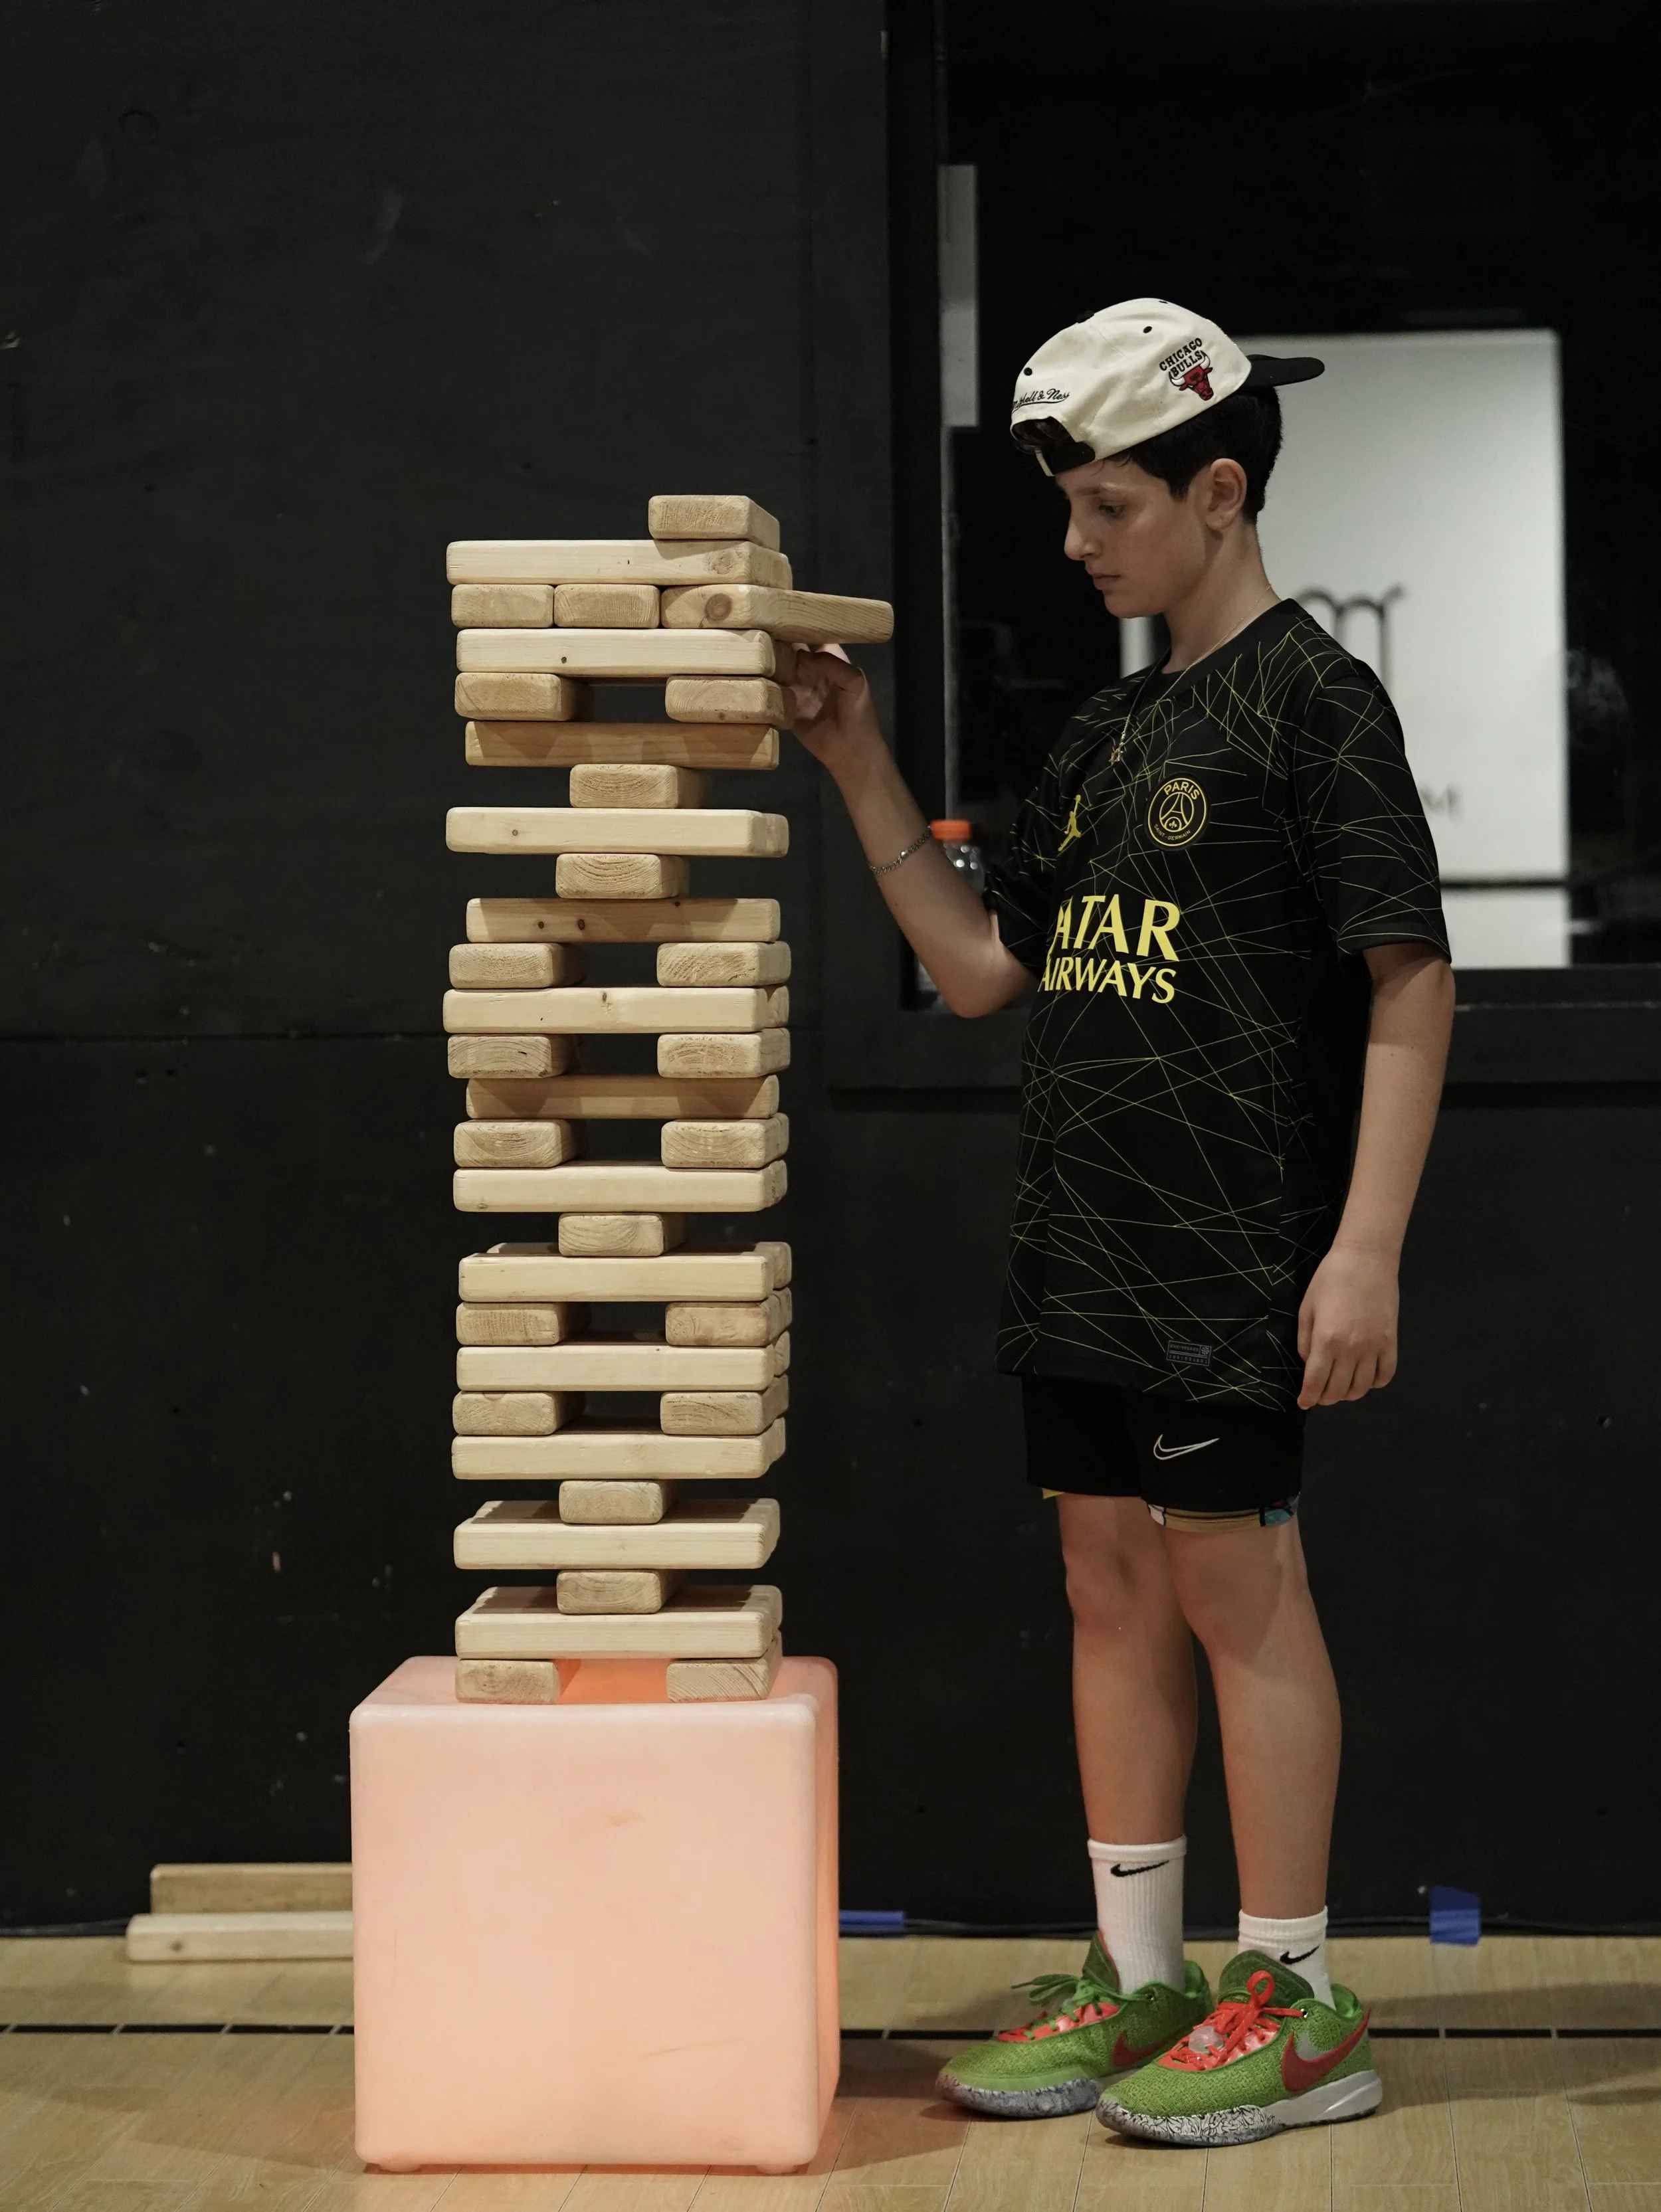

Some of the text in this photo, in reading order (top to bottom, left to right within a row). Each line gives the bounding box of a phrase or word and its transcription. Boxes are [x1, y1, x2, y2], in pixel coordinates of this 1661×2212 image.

[1159, 337, 1203, 371] CHICAGO
[1170, 350, 1203, 377] BULLS
[1012, 391, 1038, 411] hell
[1036, 390, 1045, 401] &
[1163, 781, 1201, 800] PARIS
[1047, 893, 1180, 963] ATAR
[1037, 956, 1177, 1004] AIRWAYS
